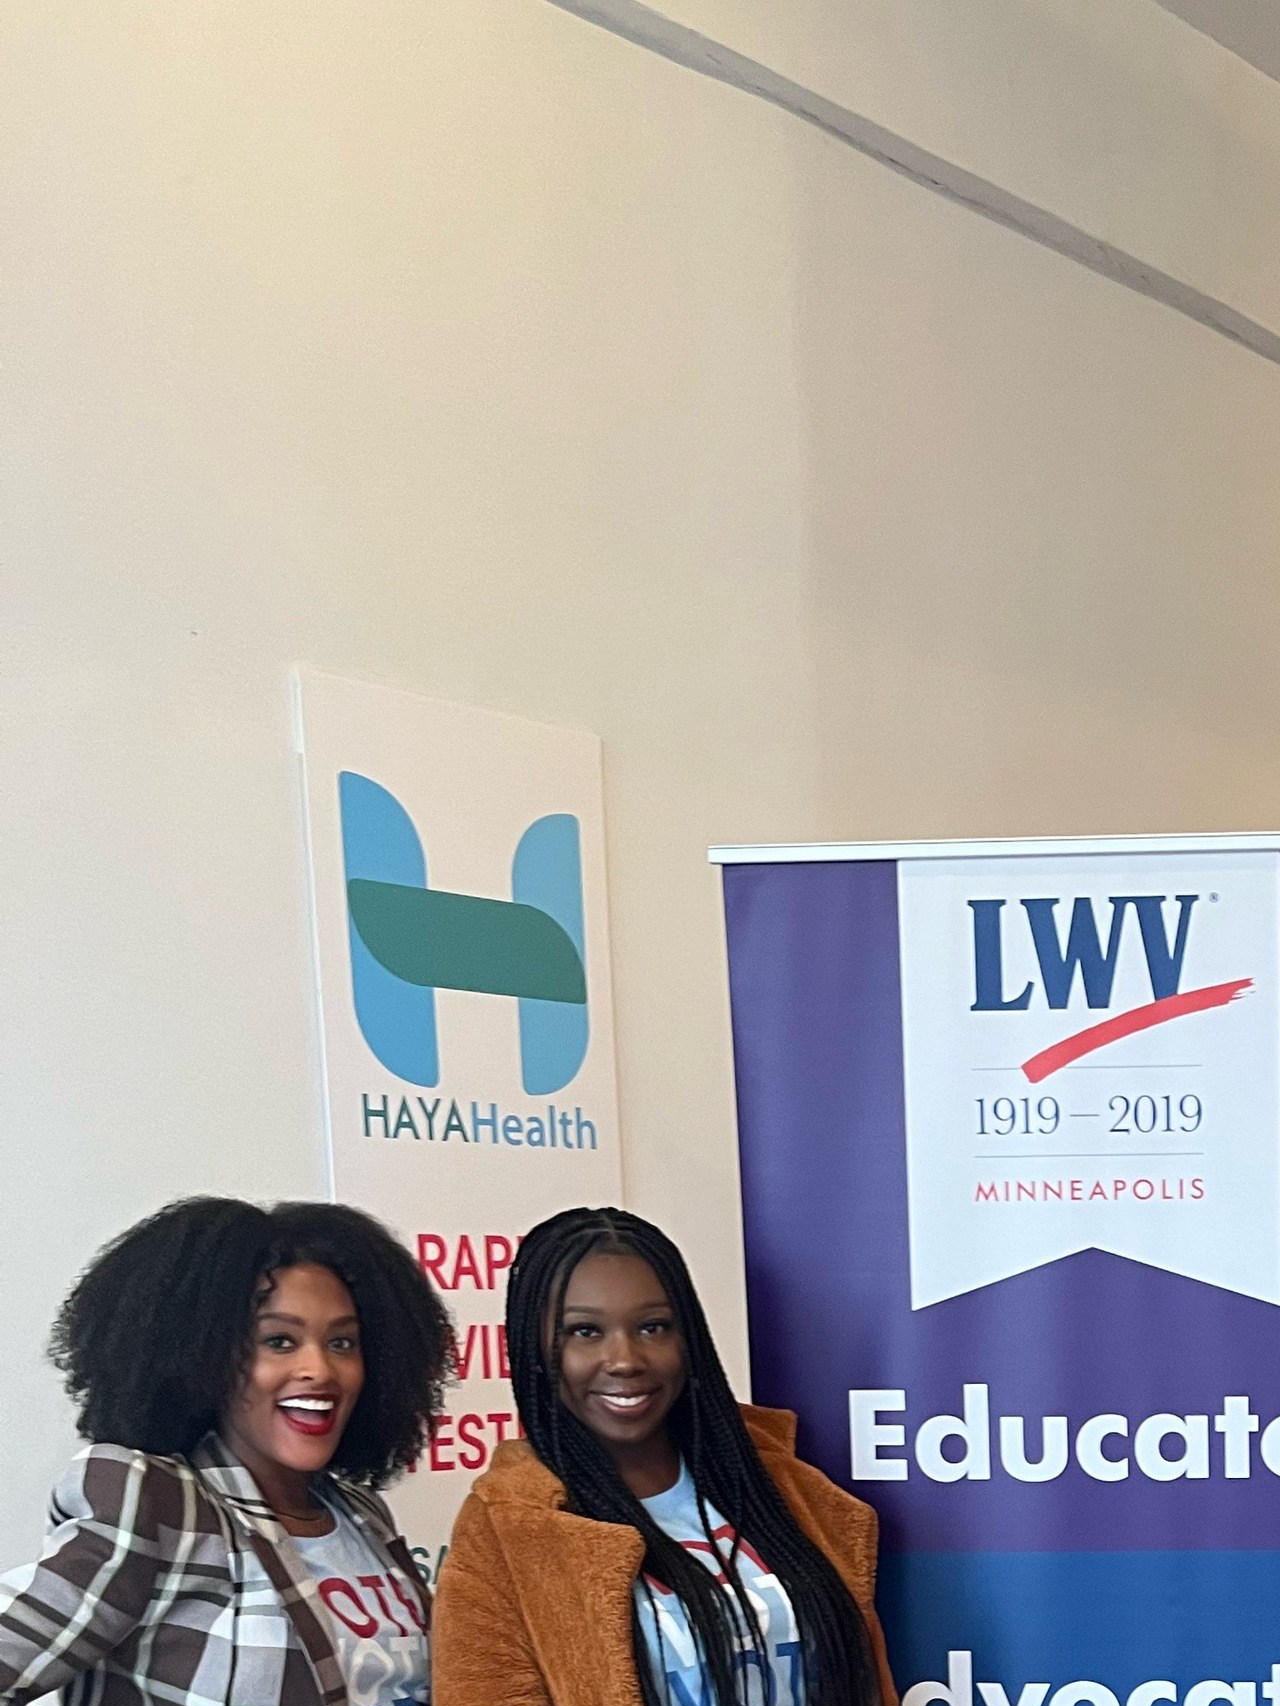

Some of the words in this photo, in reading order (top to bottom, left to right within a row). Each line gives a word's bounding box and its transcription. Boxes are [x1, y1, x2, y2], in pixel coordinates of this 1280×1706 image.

[967, 894, 1199, 1012] LWV
[361, 1092, 598, 1150] HAYAHealth
[975, 1096, 1060, 1136] 1919
[1108, 1094, 1203, 1133] 2019
[975, 1178, 1204, 1201] MINNEAPOLIS
[417, 1233, 524, 1291] RAP
[407, 1413, 524, 1473] EST
[318, 1573, 428, 1640] OT
